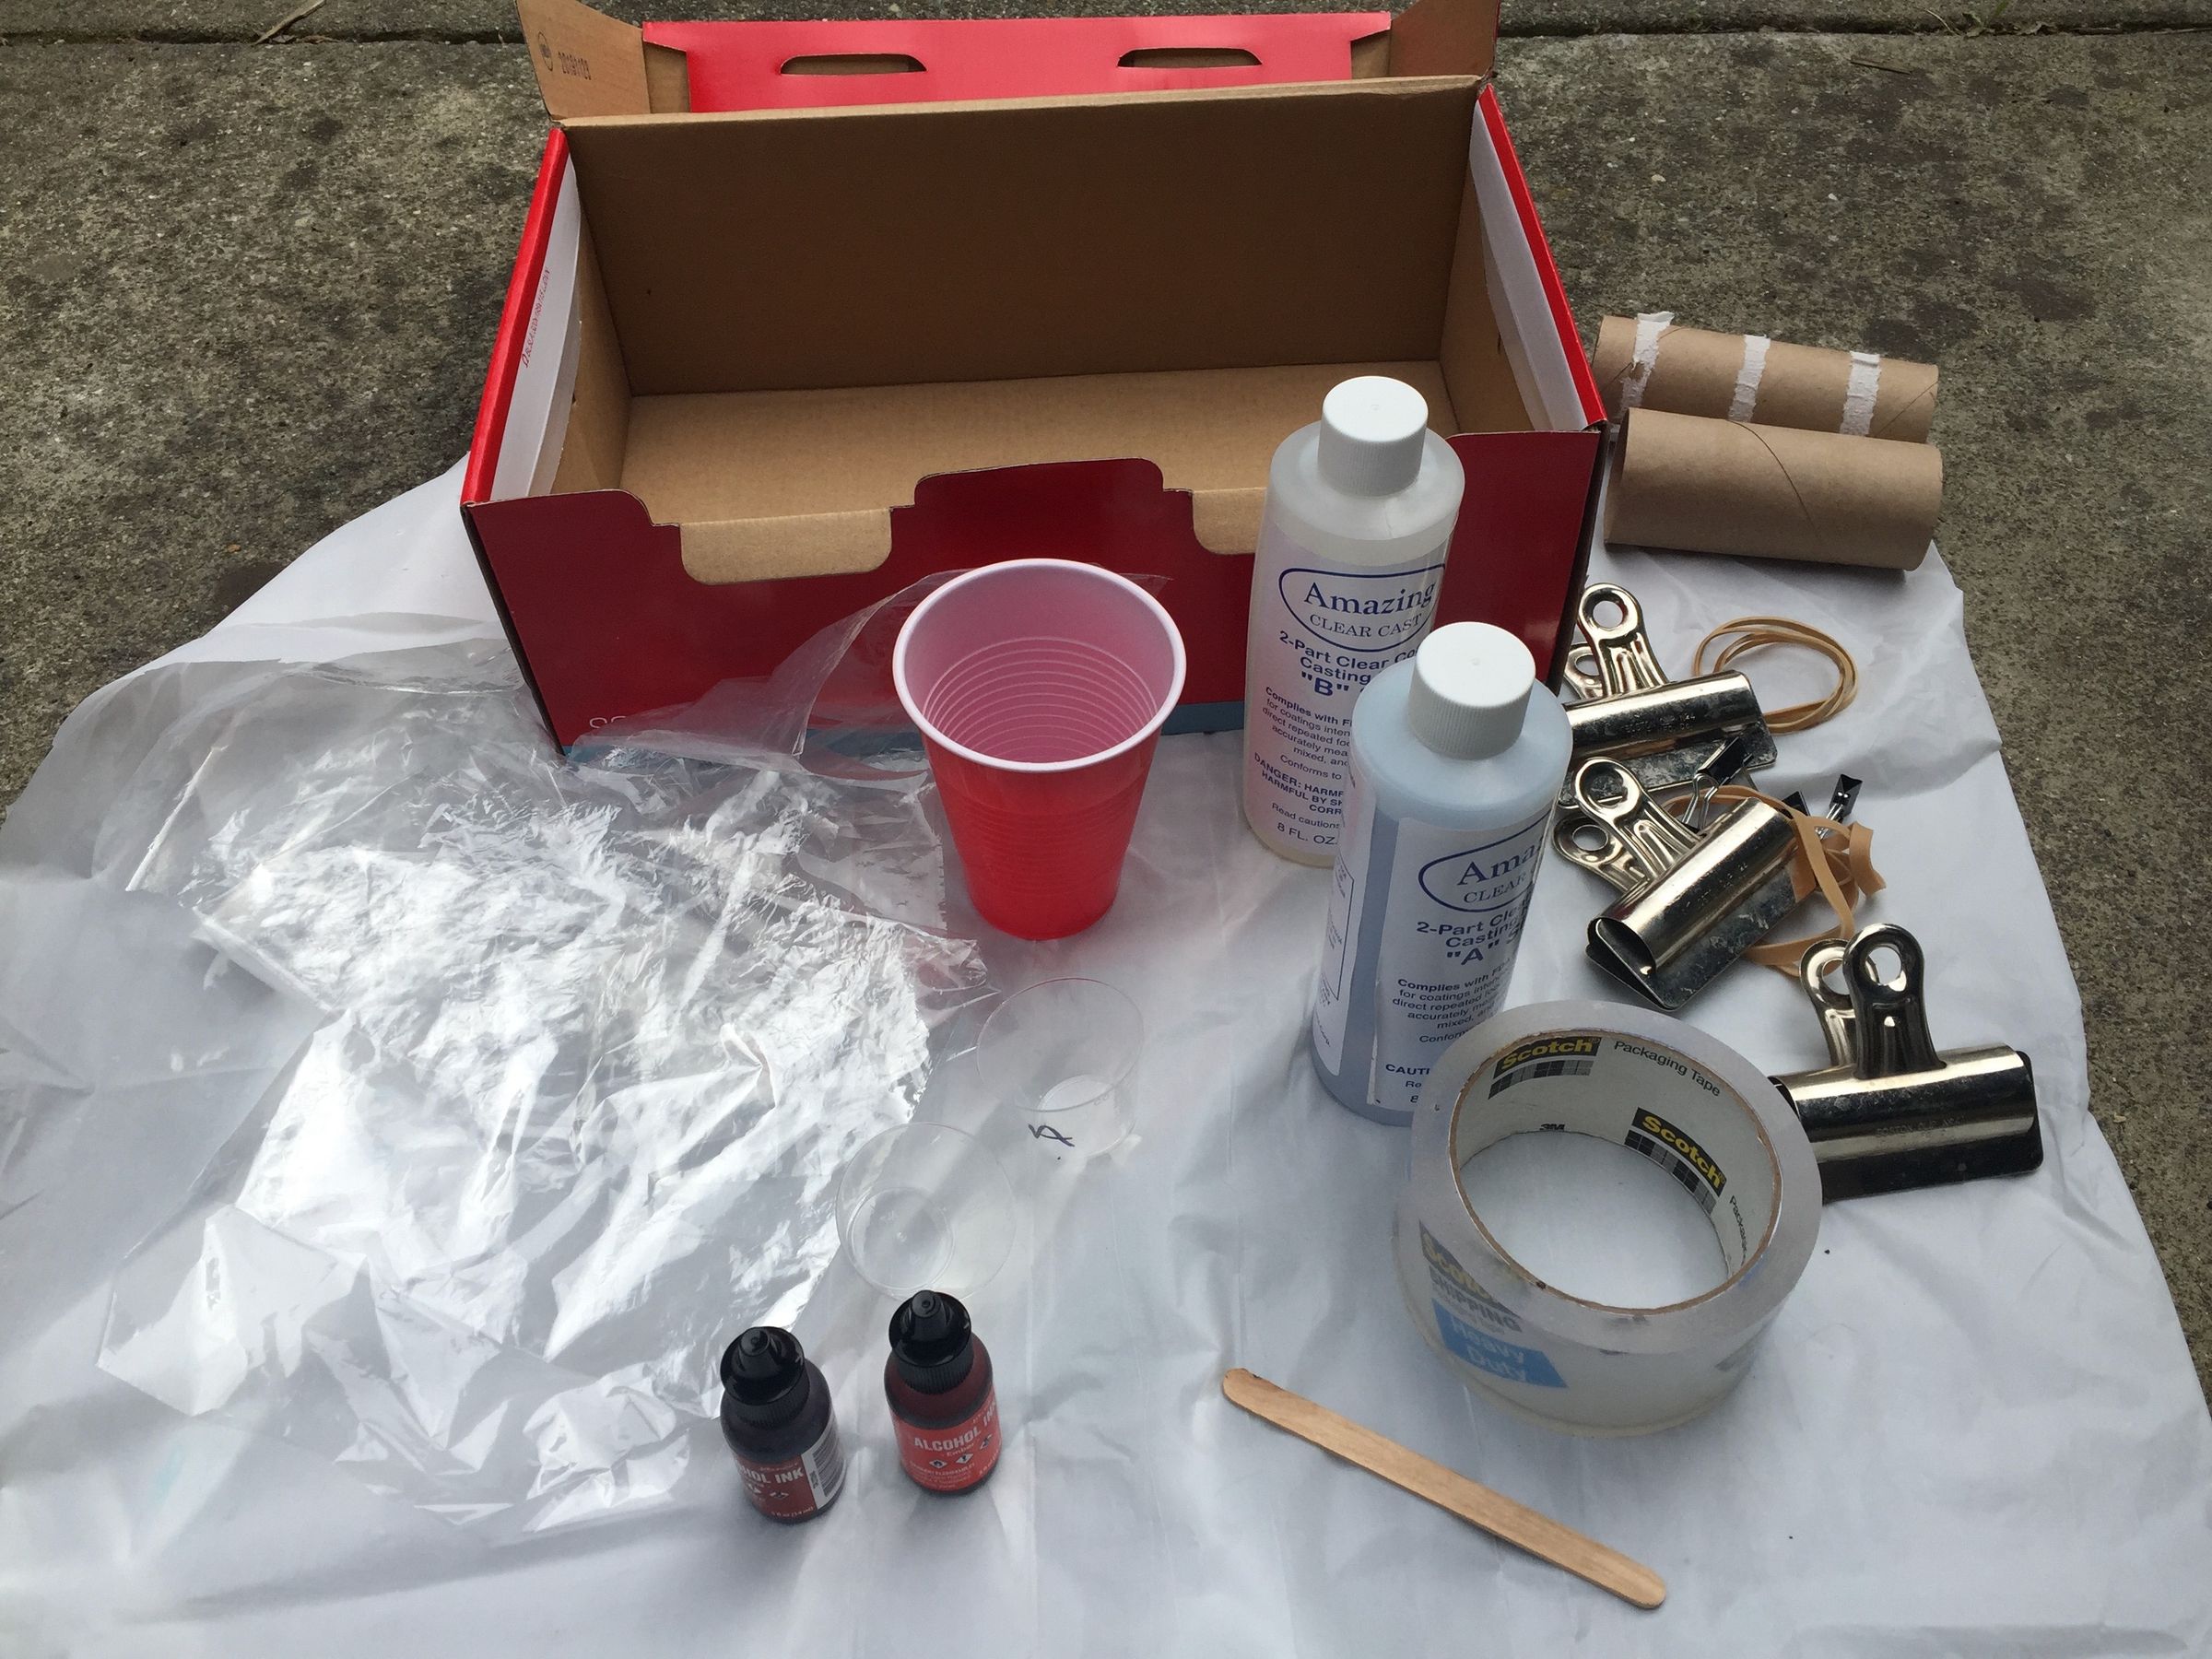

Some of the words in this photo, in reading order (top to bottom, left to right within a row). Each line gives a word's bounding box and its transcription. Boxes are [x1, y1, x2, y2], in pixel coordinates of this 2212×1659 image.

[1303, 582, 1436, 615] Amazing
[1310, 614, 1371, 638] CLEAR
[1377, 613, 1423, 637] CAST
[1279, 630, 1332, 664] 2-Part
[1336, 655, 1390, 670] Clear
[1300, 656, 1371, 686] Casting
[1300, 671, 1349, 697] "B"
[1265, 686, 1312, 717] Complies
[1314, 712, 1338, 725] with
[1266, 698, 1278, 712] for
[1279, 707, 1322, 731] coatings
[1262, 707, 1287, 727] direct
[1288, 723, 1334, 746] repeated
[1272, 724, 1322, 753] accurately
[1253, 751, 1301, 789] DANGER:
[1279, 754, 1329, 779] Conforms
[1332, 772, 1342, 781] to
[1261, 770, 1309, 801] HARMFUL
[1312, 794, 1328, 805] BY
[1272, 802, 1297, 820] Read
[1277, 822, 1285, 832] 8
[1288, 827, 1309, 841] FL.
[1416, 921, 1484, 935] 2-Part
[1446, 938, 1500, 966] "A"
[1397, 978, 1461, 994] Complies
[1464, 974, 1489, 988] with
[1399, 989, 1417, 999] for
[1419, 990, 1471, 1002] coatings
[1392, 997, 1427, 1011] direct
[1430, 994, 1482, 1012] repeated
[1407, 1007, 1469, 1021] accurately
[1614, 1040, 1688, 1077] Packaging
[1690, 1067, 1722, 1098] Tape
[1641, 1114, 1721, 1189] Scotch
[914, 1426, 982, 1453] ALCOHOL
[774, 1466, 804, 1484] INK
